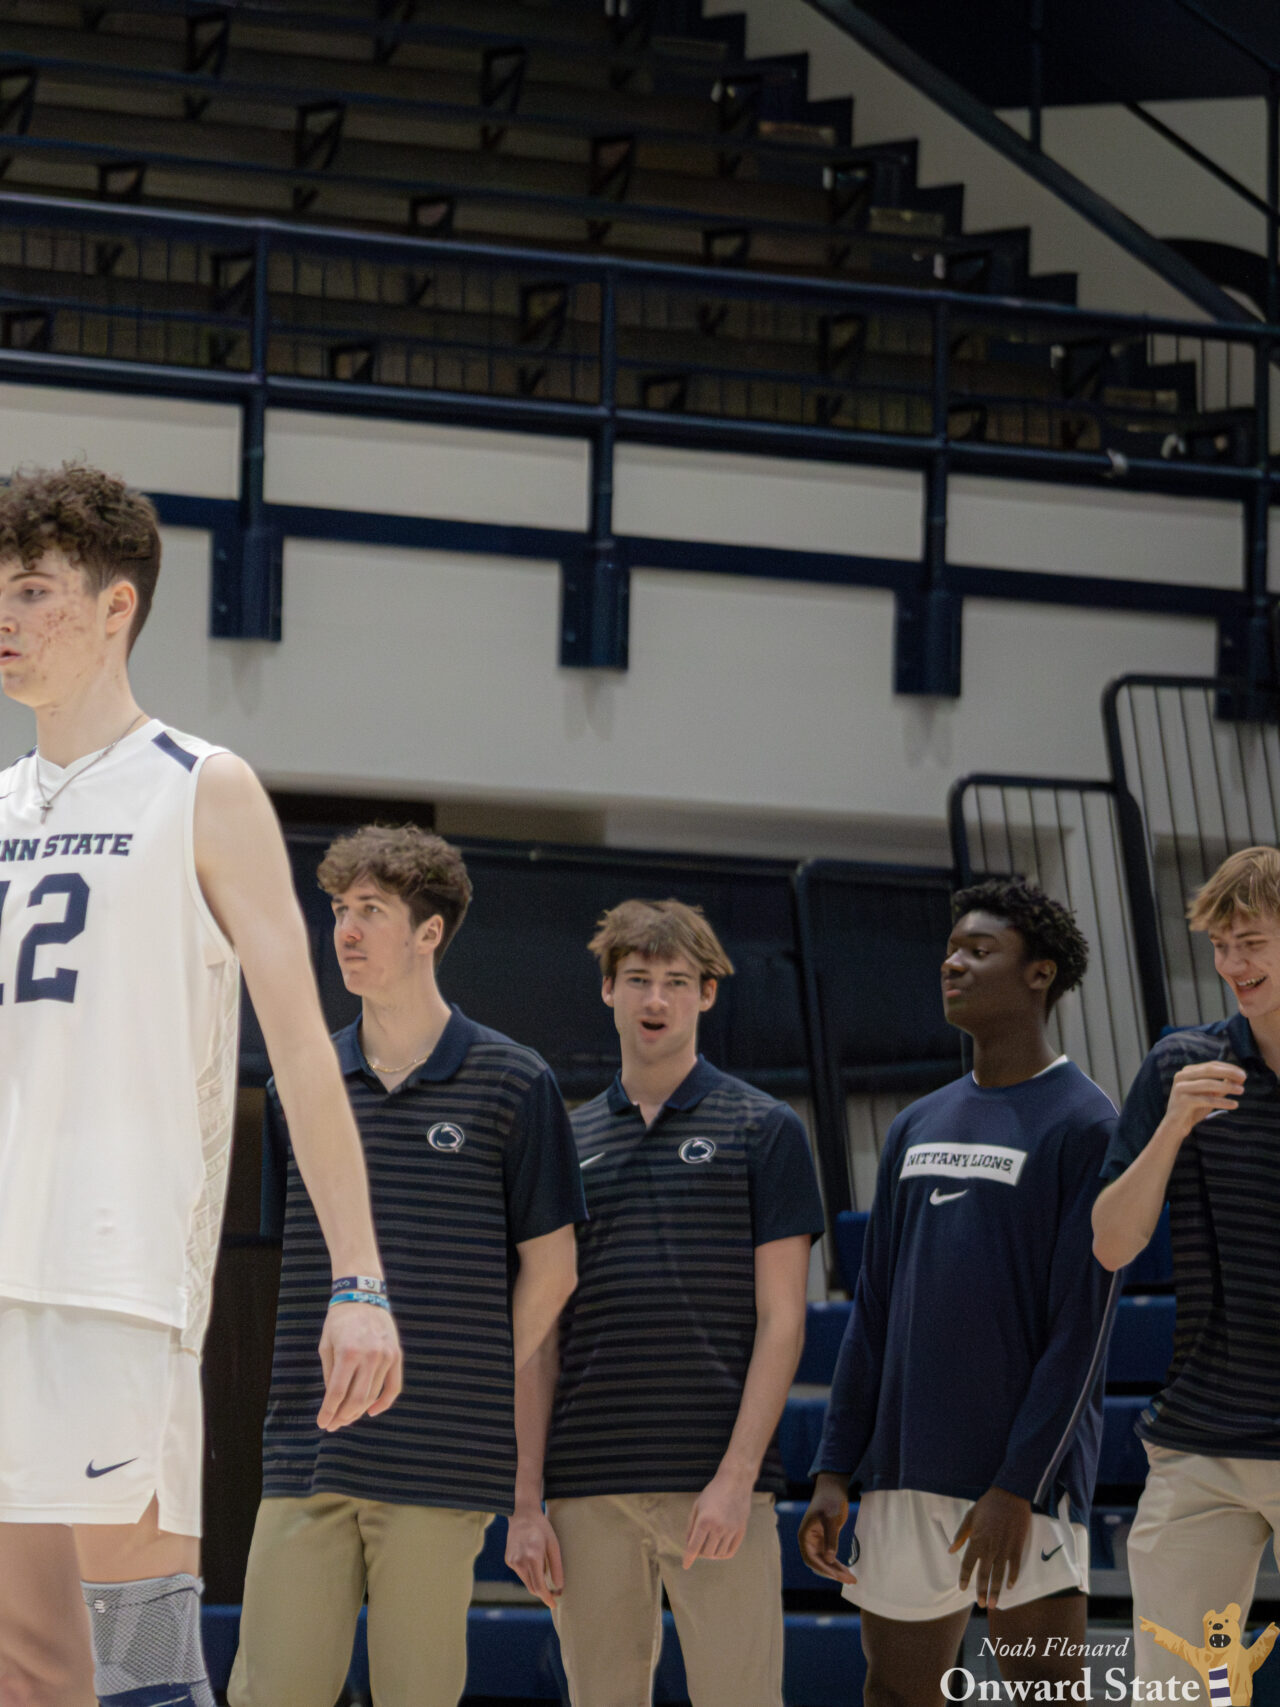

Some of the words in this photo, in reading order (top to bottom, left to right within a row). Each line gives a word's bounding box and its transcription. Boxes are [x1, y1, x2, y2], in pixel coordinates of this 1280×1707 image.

[42, 833, 133, 858] STATE
[907, 1151, 970, 1168] NITTANY
[970, 1153, 1013, 1172] LIONS
